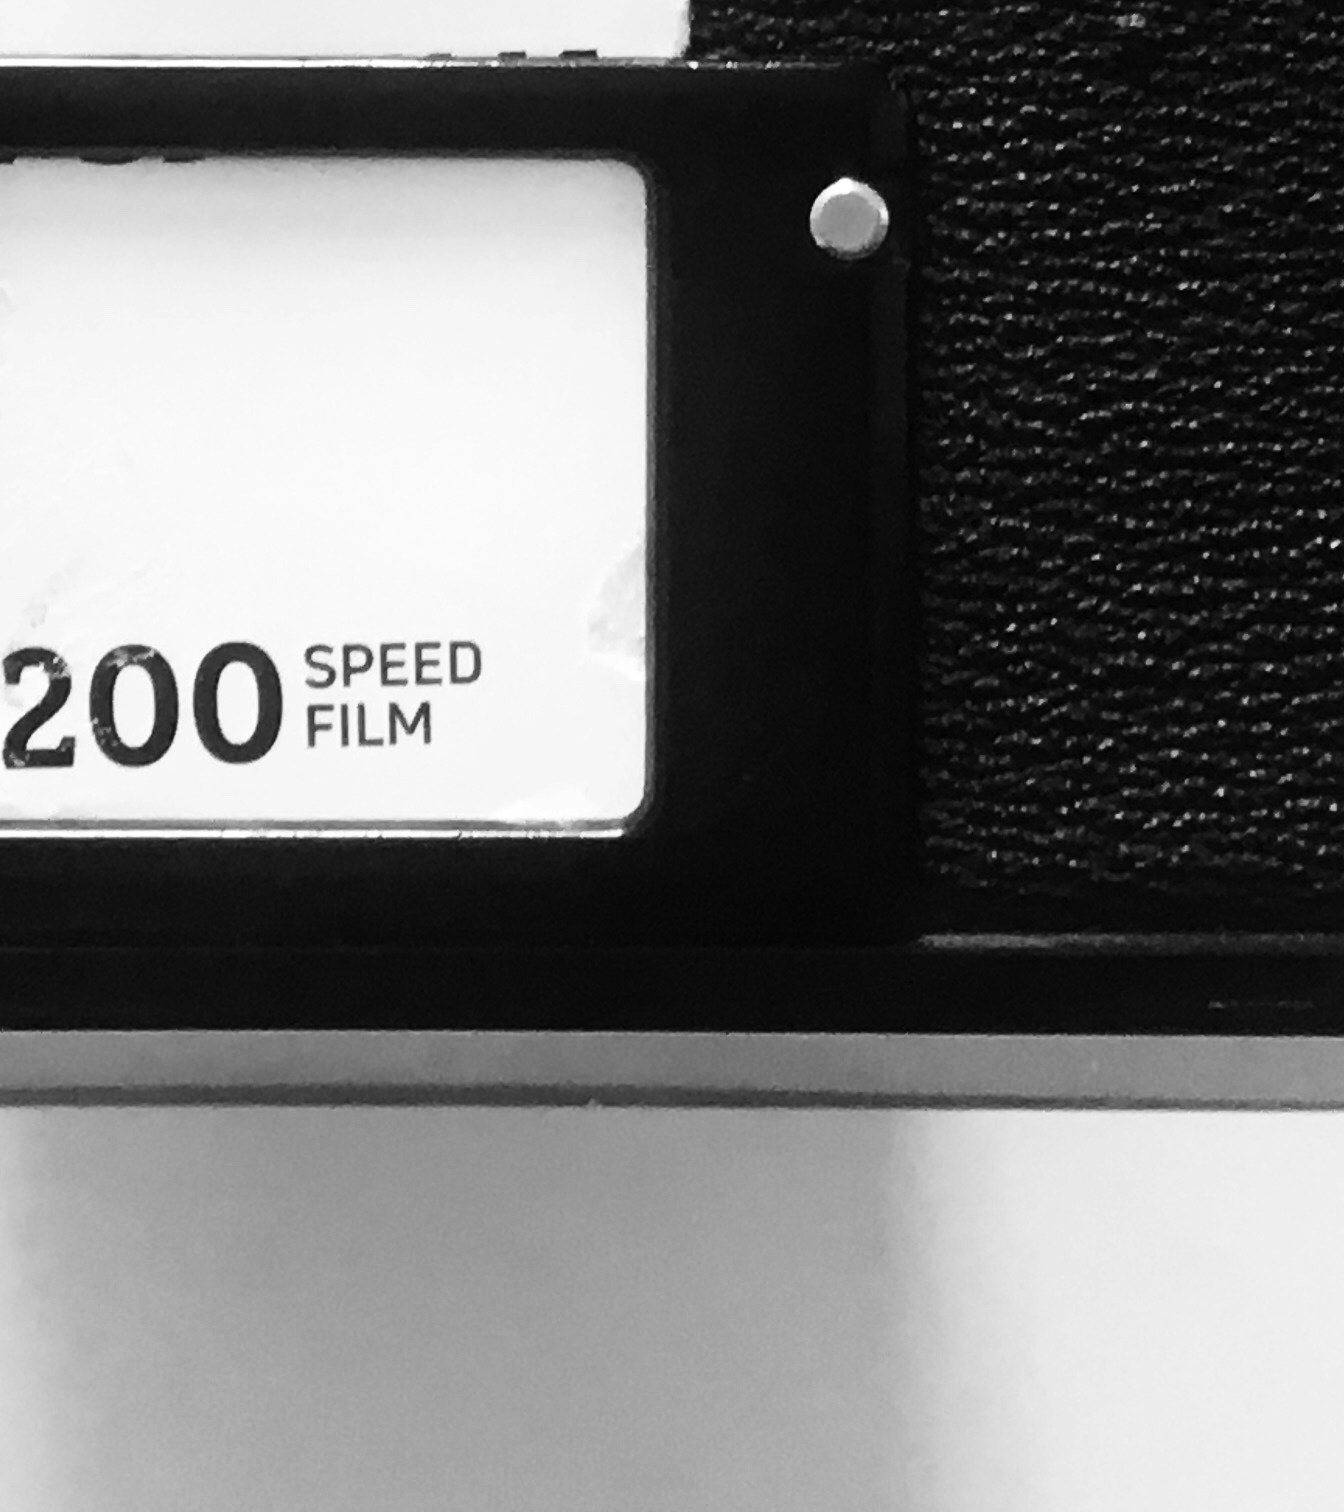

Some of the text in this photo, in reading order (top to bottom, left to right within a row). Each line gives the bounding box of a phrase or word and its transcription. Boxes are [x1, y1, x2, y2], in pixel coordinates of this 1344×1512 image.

[2, 640, 482, 769] 200 SPEED
[307, 701, 432, 748] FILM
